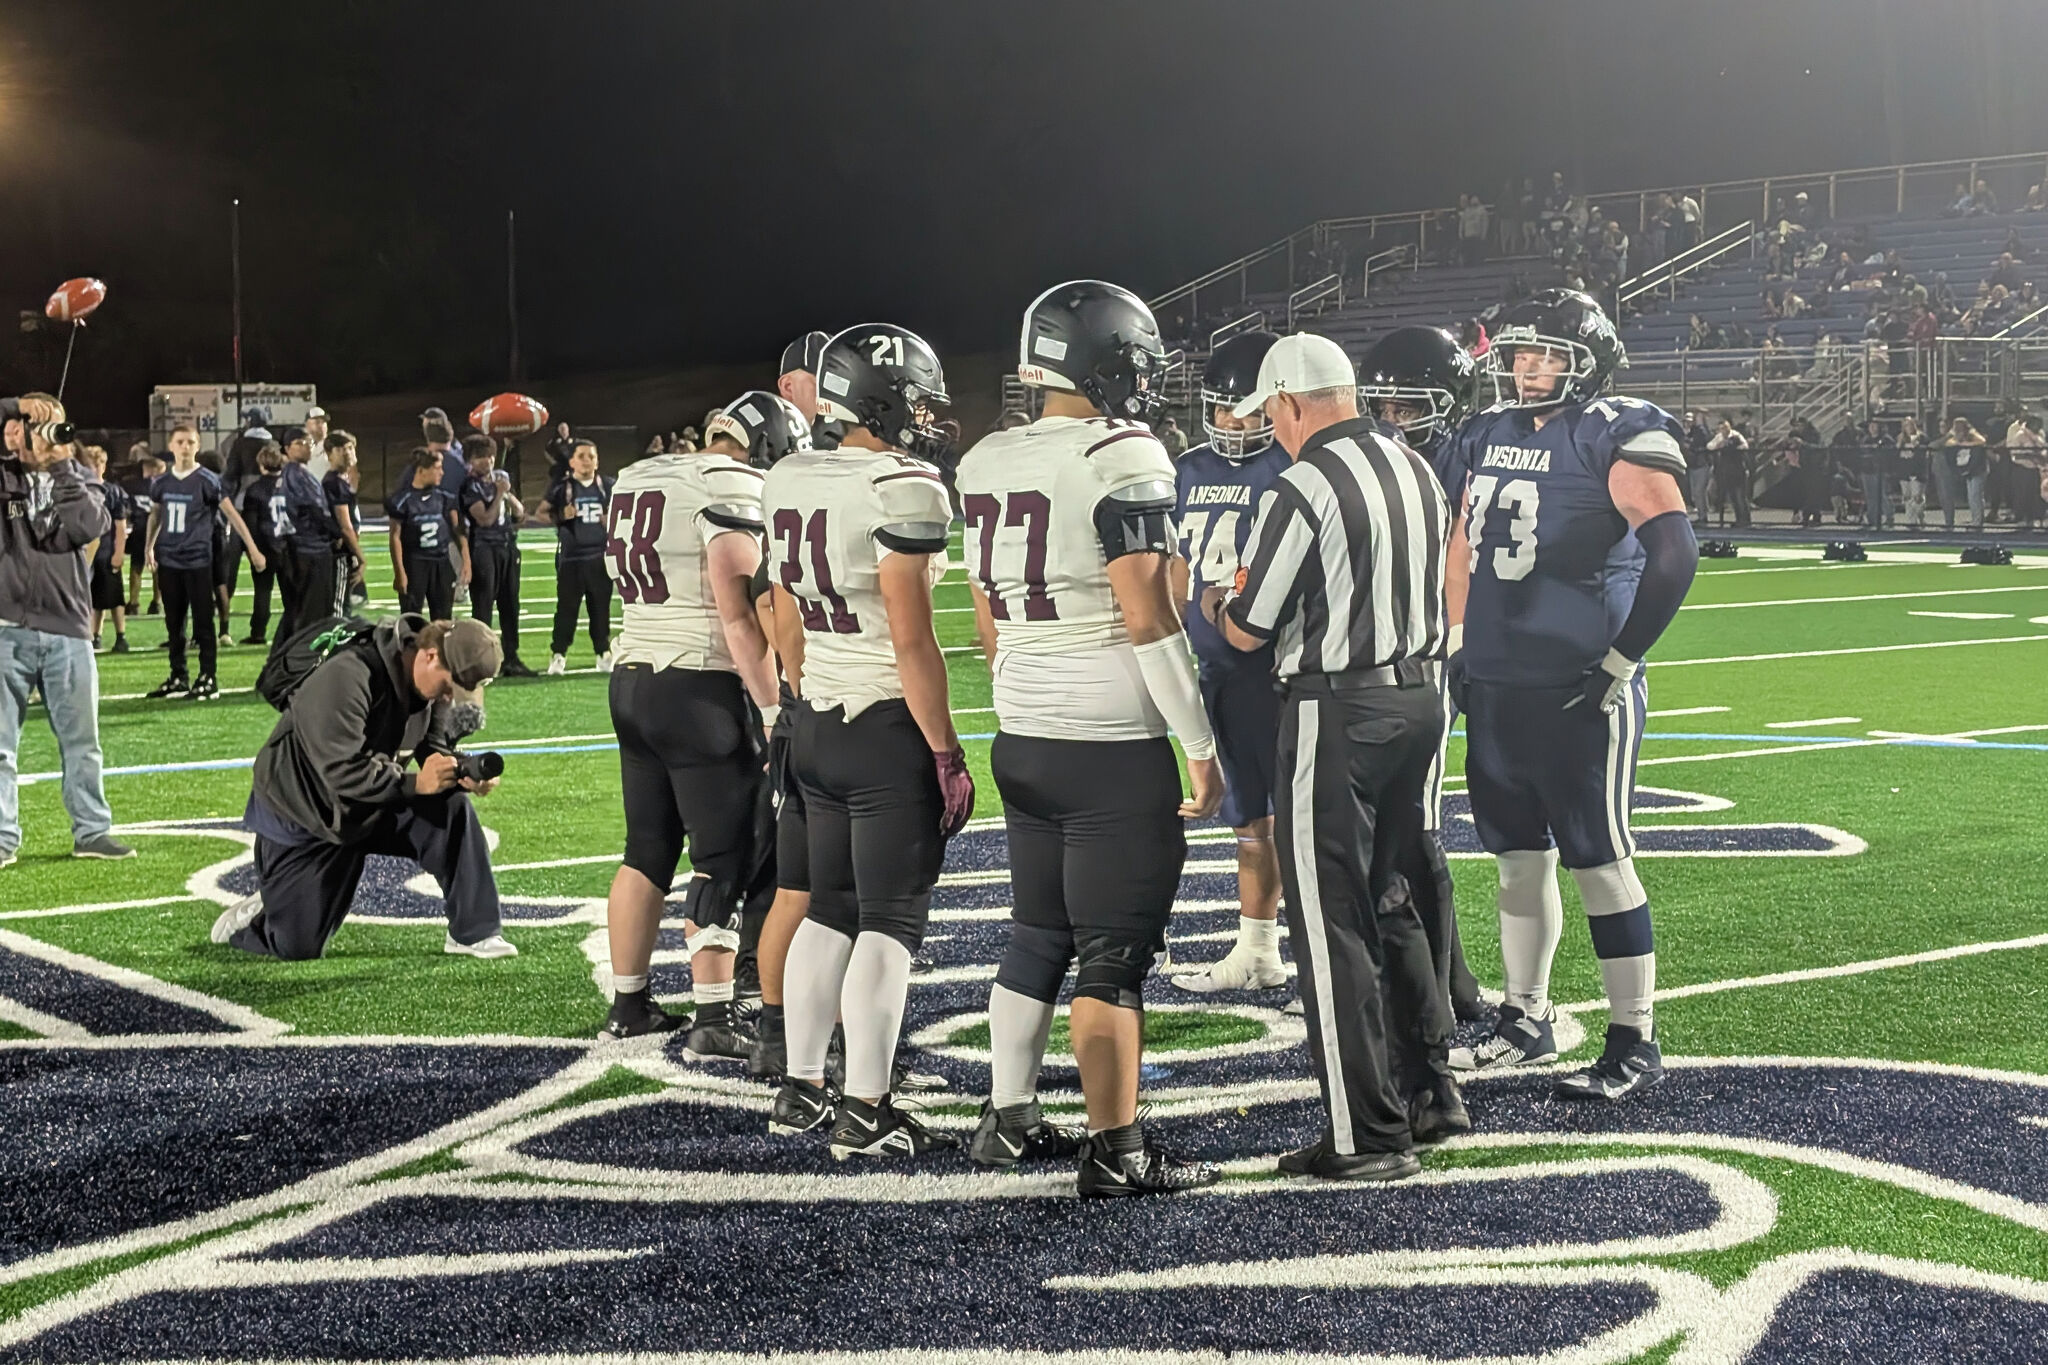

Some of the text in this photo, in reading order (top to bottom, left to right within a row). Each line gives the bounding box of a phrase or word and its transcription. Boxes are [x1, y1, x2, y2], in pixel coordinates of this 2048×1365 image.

[869, 335, 904, 366] 21
[1482, 445, 1551, 472] ANSONIA
[1186, 485, 1251, 506] ANSONIA
[167, 501, 187, 533] 11
[575, 503, 603, 523] 42
[1468, 475, 1540, 581] 73
[420, 521, 439, 548] 2
[606, 490, 671, 605] 58
[773, 508, 863, 633] 21
[963, 490, 1061, 621] 77
[1179, 510, 1241, 601] 74
